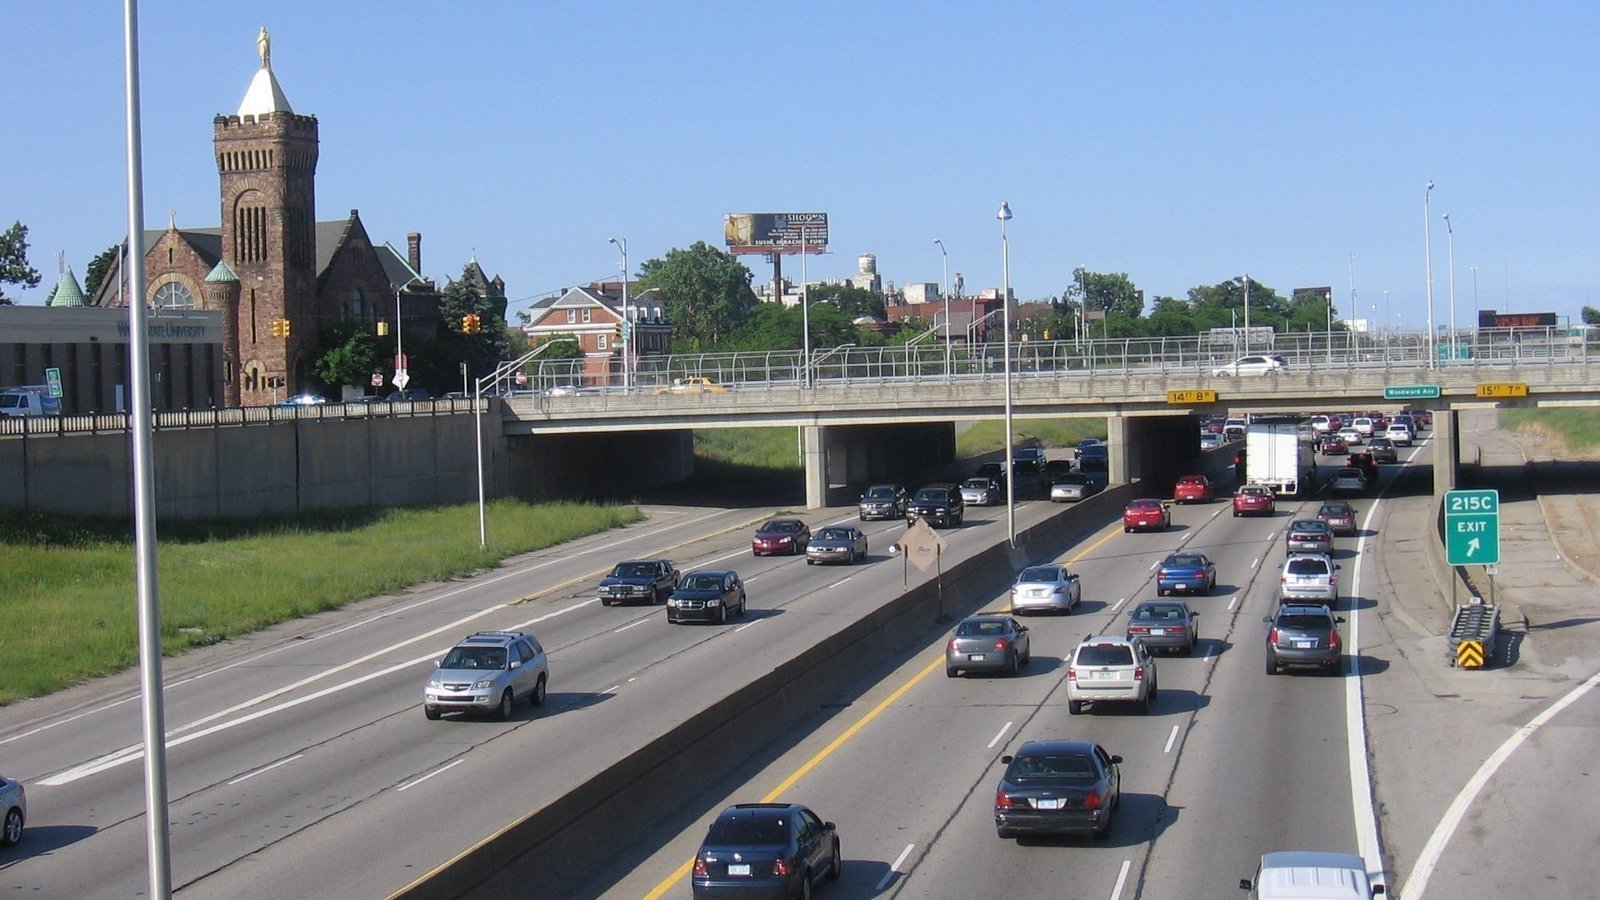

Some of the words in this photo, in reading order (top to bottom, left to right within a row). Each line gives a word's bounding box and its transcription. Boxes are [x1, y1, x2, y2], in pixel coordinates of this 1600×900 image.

[148, 325, 165, 338] TATE
[165, 321, 206, 338] UNIVERSITY
[1452, 496, 1491, 510] 215C
[1457, 521, 1487, 533] EXIT
